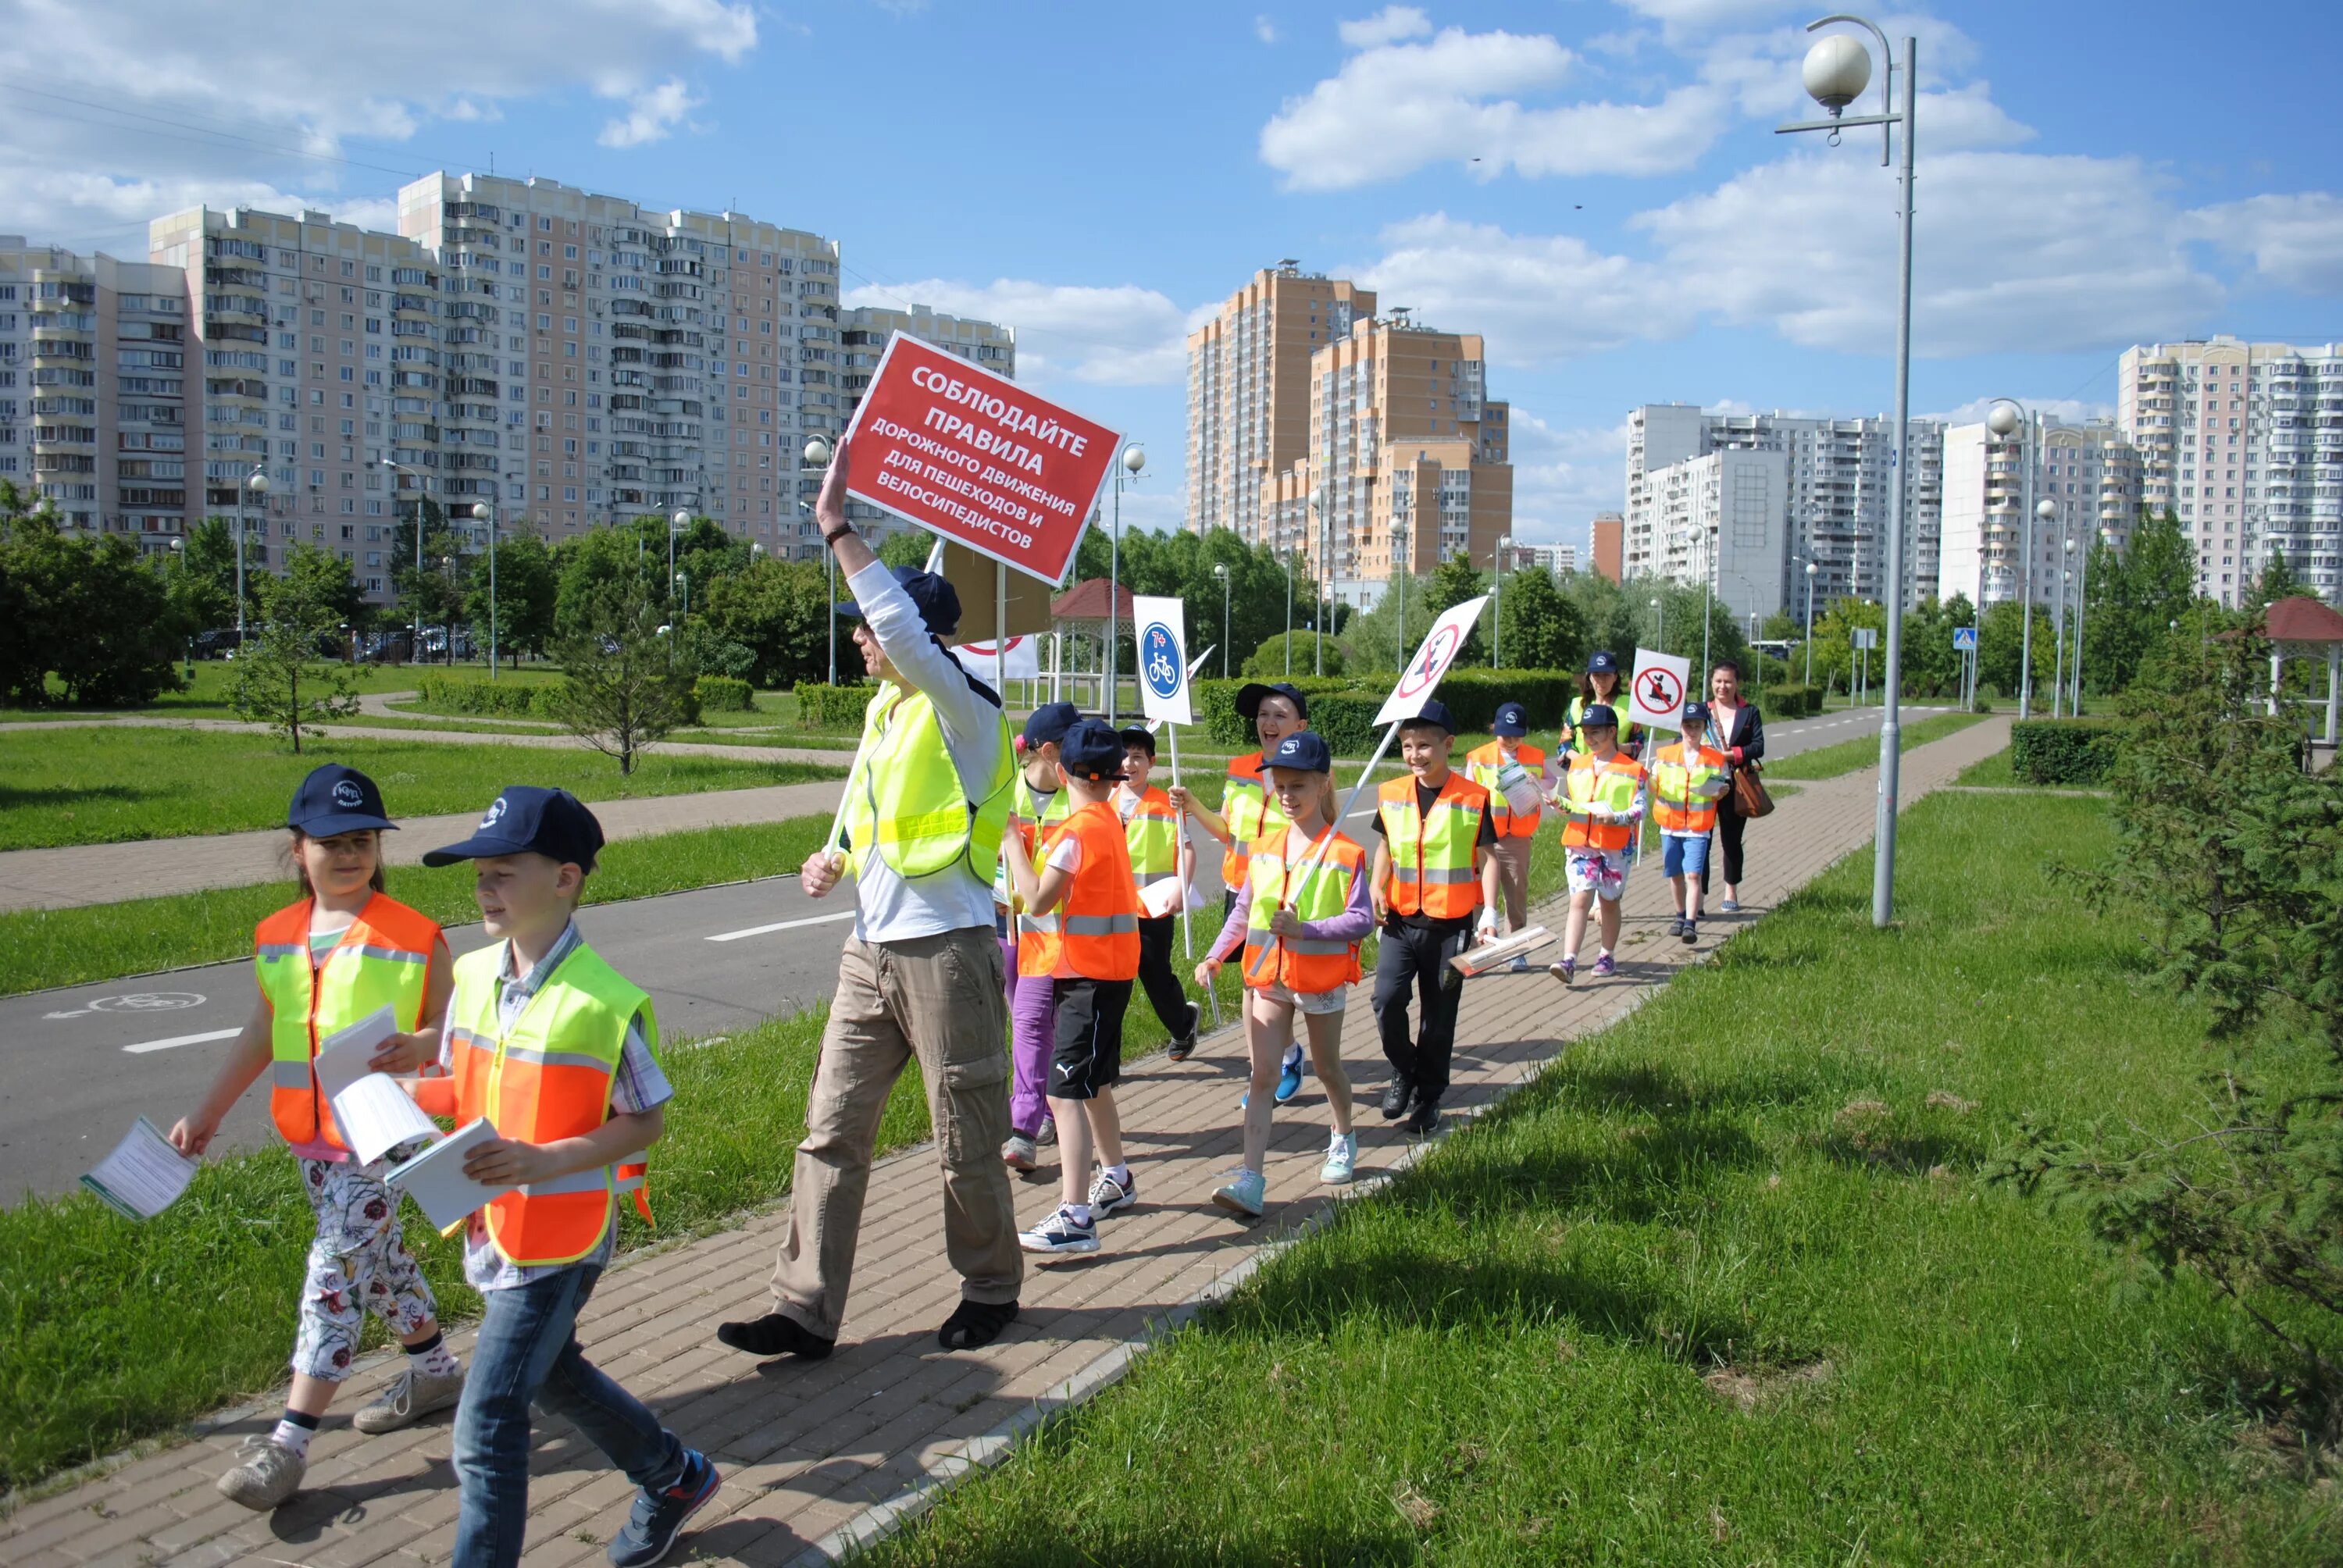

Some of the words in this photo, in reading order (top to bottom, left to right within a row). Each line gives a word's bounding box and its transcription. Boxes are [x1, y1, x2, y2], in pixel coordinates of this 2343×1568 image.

[911, 366, 1088, 458] СОБЛЮДАЙТЕ
[924, 406, 1043, 476] ПРАВИЛА
[869, 417, 980, 473] ДОРОЖНОГО
[979, 465, 1076, 517] ДВИЖЕНИЯ
[883, 449, 923, 475] ДЛЯ
[922, 465, 1027, 521] ПЕШЕХОДОВ
[1028, 511, 1043, 529] И
[876, 470, 1032, 549] ВЕЛОСИПЕДИСТОВ
[1151, 631, 1166, 648] 7+
